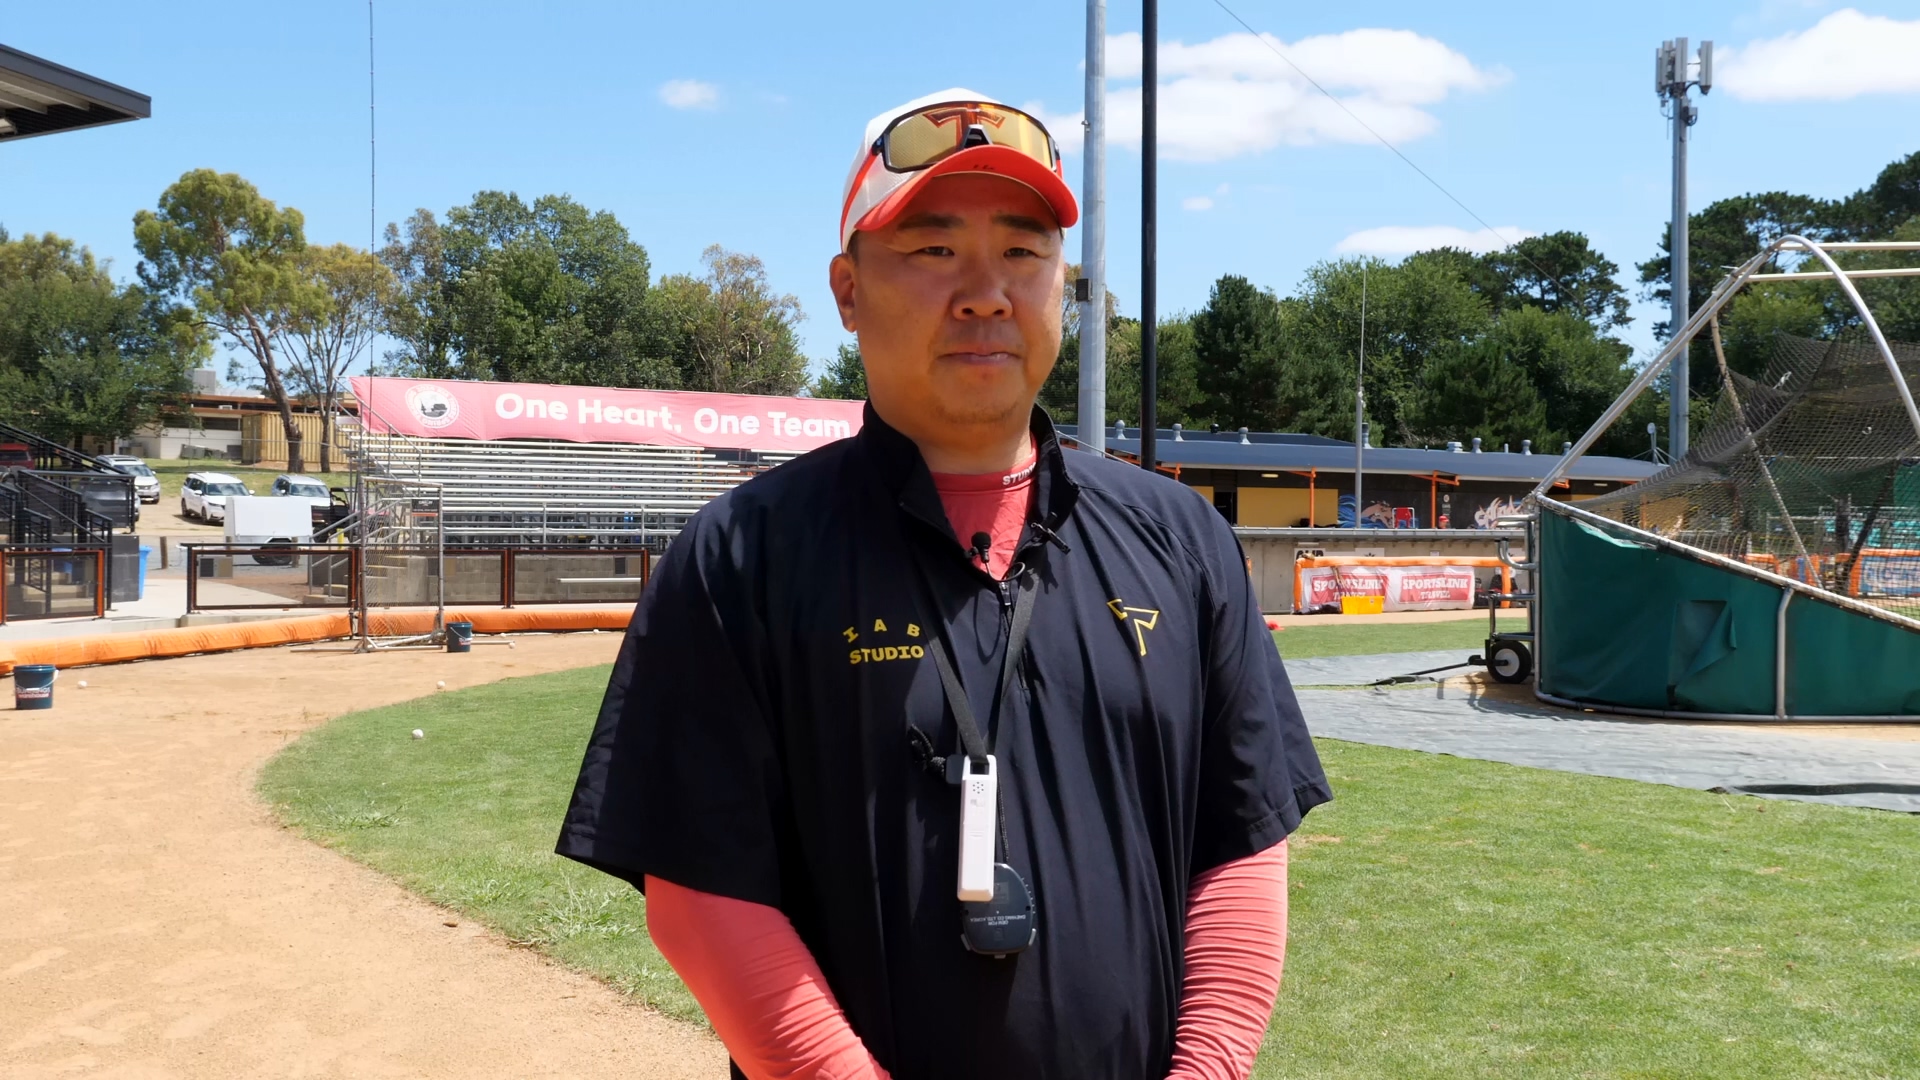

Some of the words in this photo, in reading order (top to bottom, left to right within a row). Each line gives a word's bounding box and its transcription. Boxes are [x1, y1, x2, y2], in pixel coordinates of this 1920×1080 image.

[495, 392, 569, 420] One
[578, 398, 682, 433] Heart,
[694, 407, 760, 435] One
[767, 411, 851, 438] Team
[1402, 577, 1469, 590] SPORTSLINK
[850, 645, 924, 664] STUDIO
